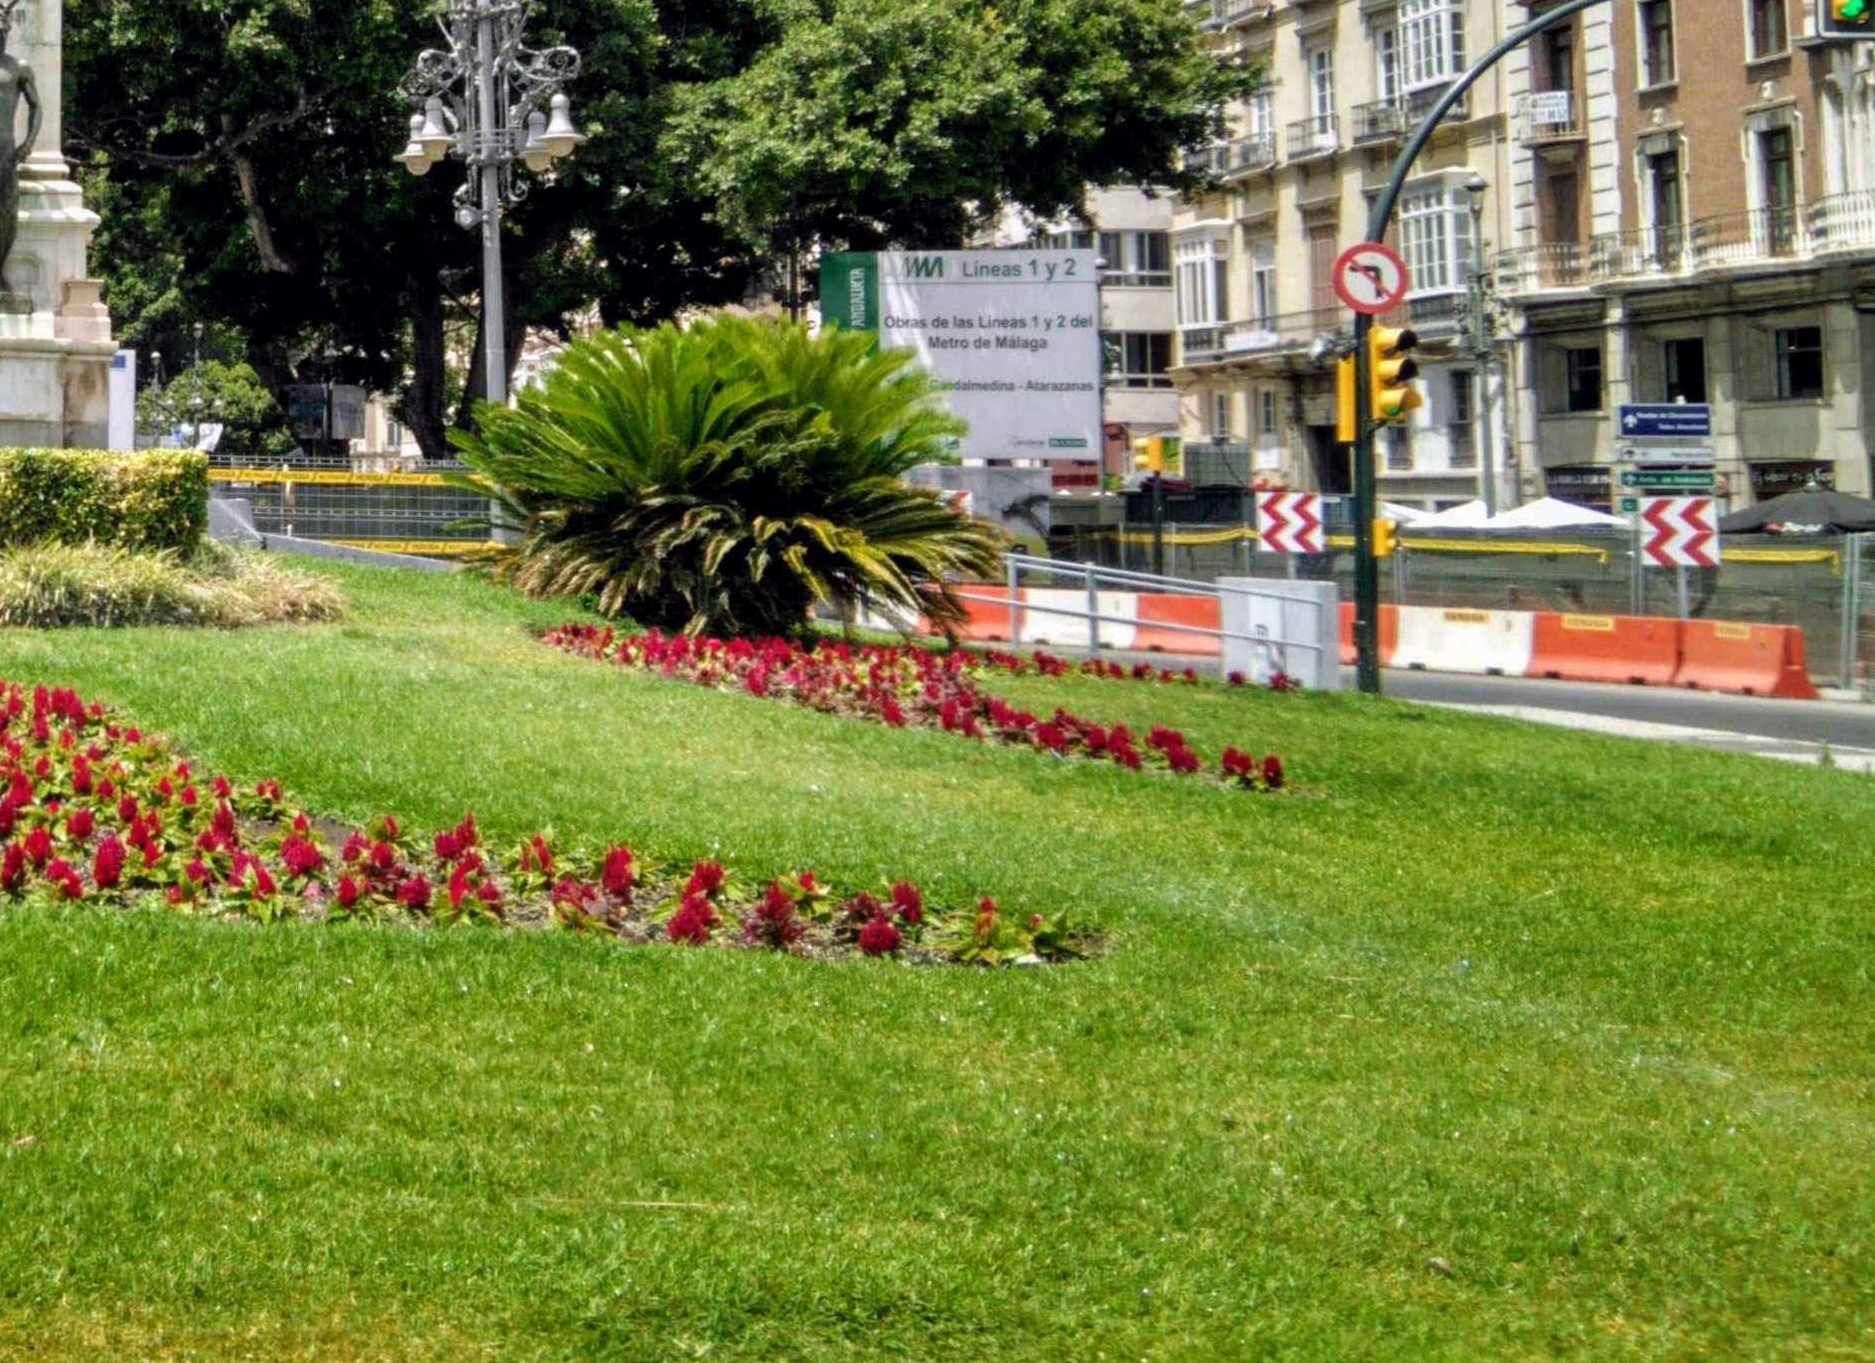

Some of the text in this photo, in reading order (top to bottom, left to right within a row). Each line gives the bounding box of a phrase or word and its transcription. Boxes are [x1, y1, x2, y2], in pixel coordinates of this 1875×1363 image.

[962, 258, 1077, 281] Líneas 1 y 2
[884, 314, 1093, 332] Obras de las Líneas 1 y 2 del
[928, 335, 1048, 351] Metro de Málaga
[1026, 380, 1094, 392] Atarazanas
